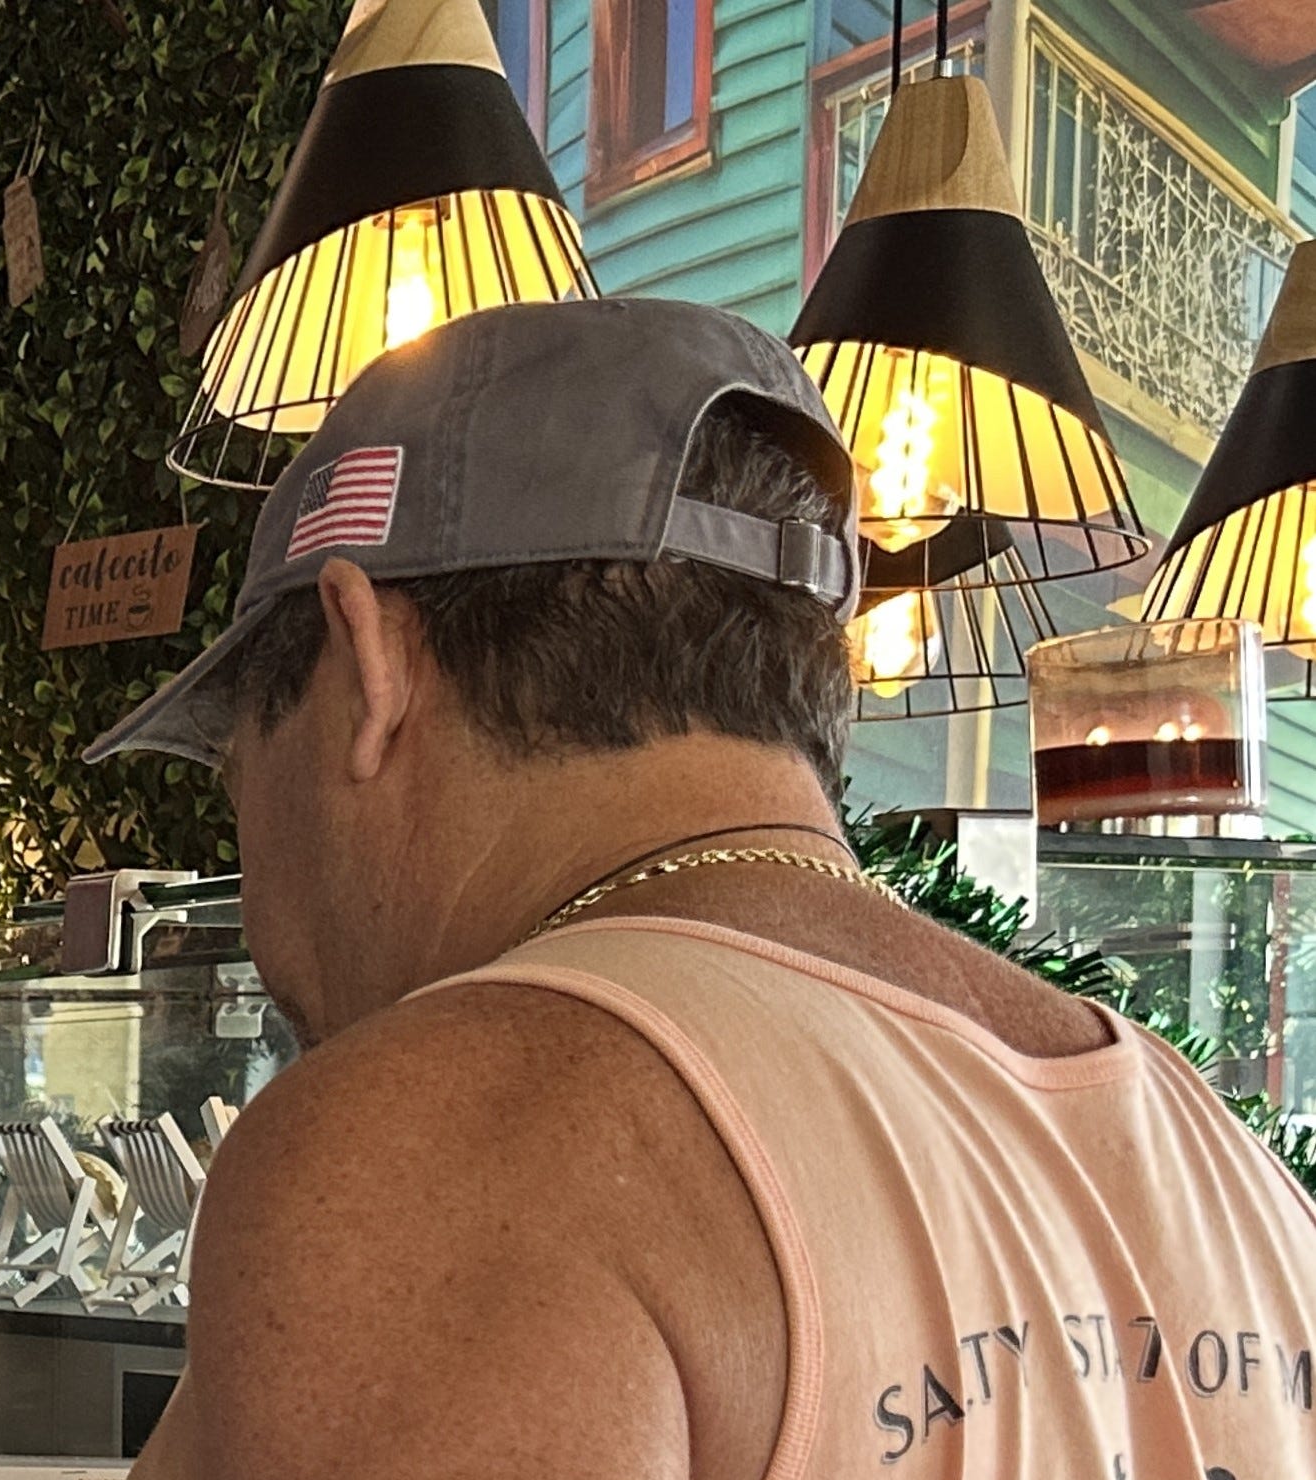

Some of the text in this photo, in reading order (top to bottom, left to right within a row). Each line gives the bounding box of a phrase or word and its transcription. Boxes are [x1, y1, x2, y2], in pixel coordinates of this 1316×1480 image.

[58, 533, 183, 592] cafecito
[65, 601, 121, 631] TIME
[874, 1321, 1030, 1462] SATY
[1186, 1330, 1263, 1398] OF
